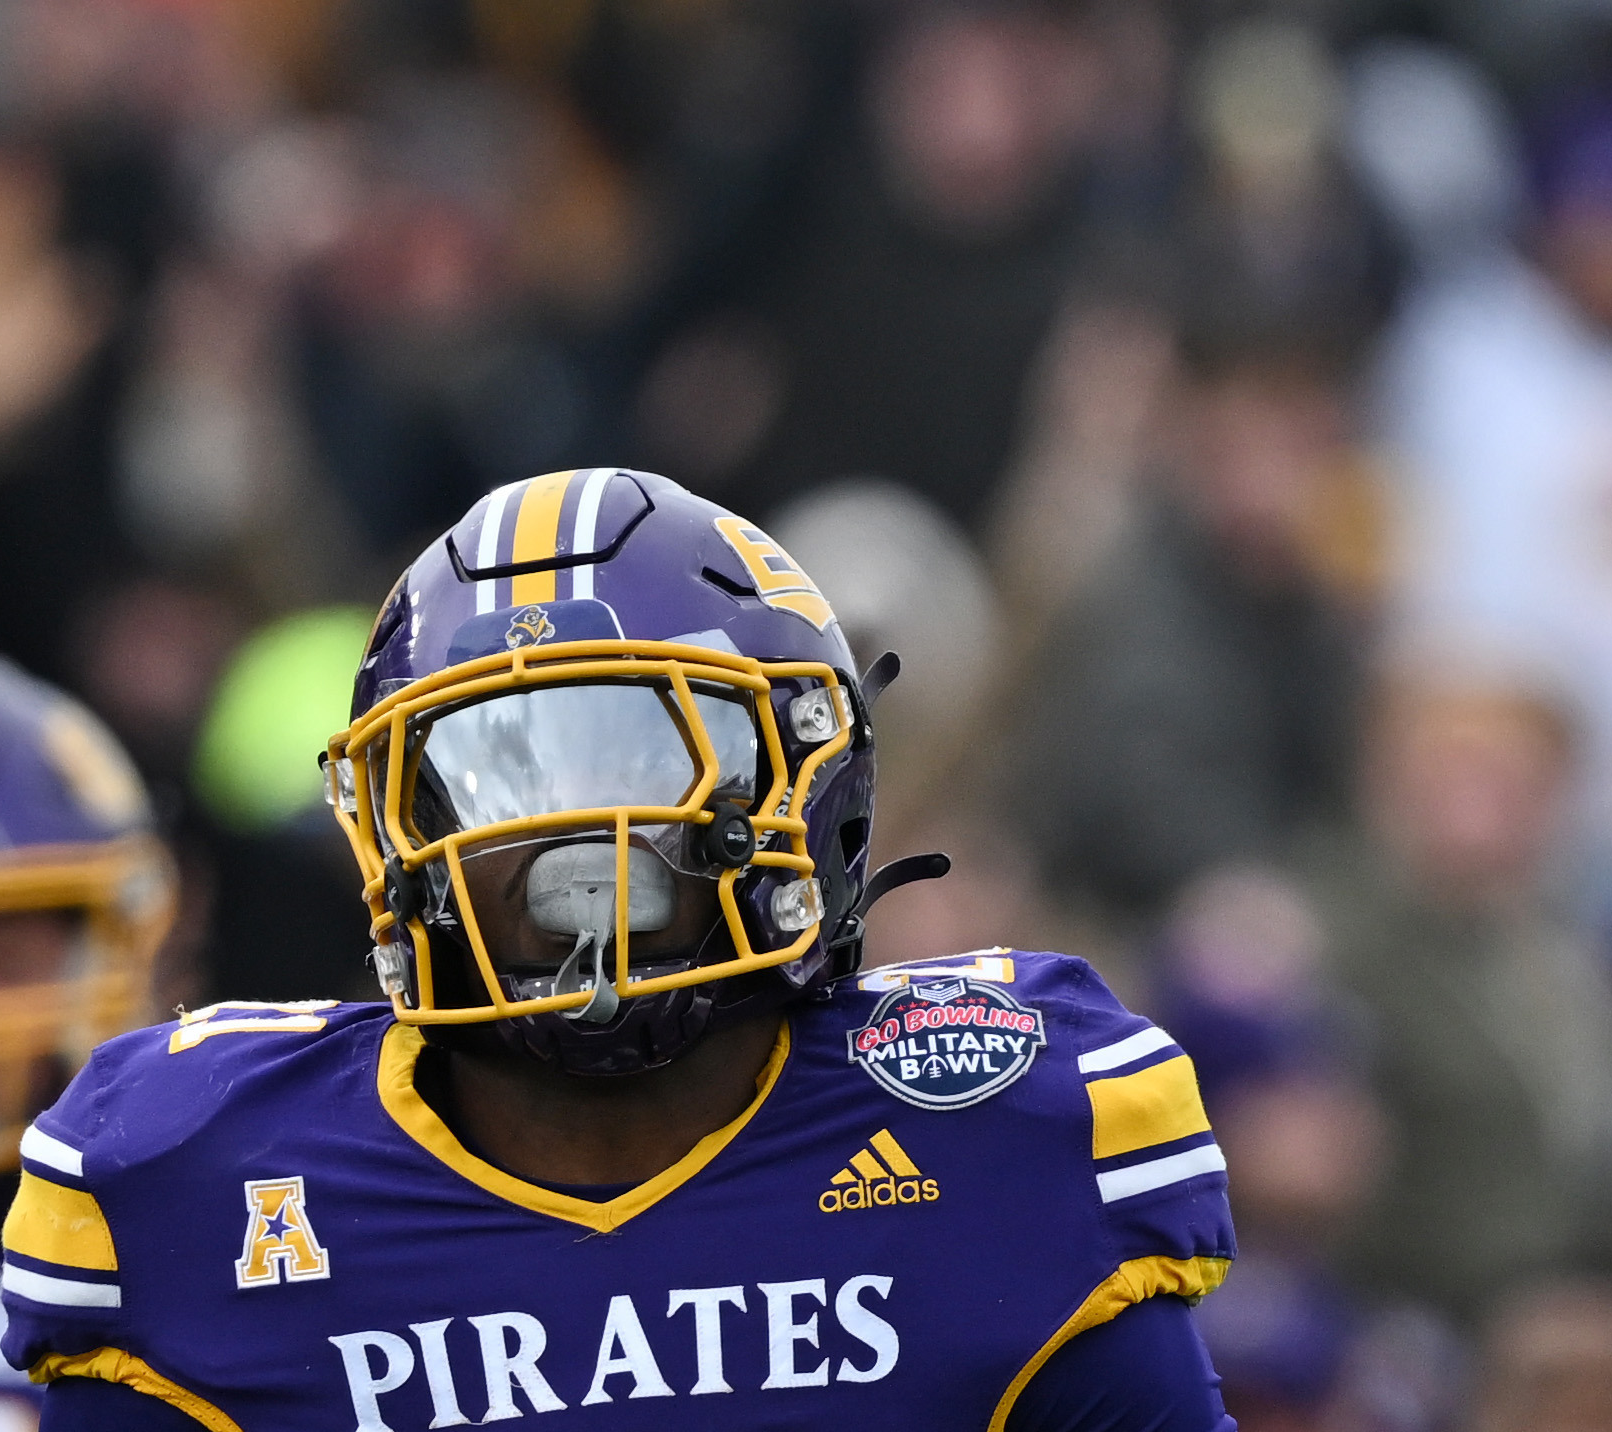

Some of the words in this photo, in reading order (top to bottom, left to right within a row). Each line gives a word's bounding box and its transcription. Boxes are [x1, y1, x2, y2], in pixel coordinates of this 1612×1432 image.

[856, 1018, 900, 1052] GO
[904, 1005, 1036, 1034] BOWLING
[868, 1031, 1027, 1064] MILITARY
[818, 1176, 940, 1213] adidas
